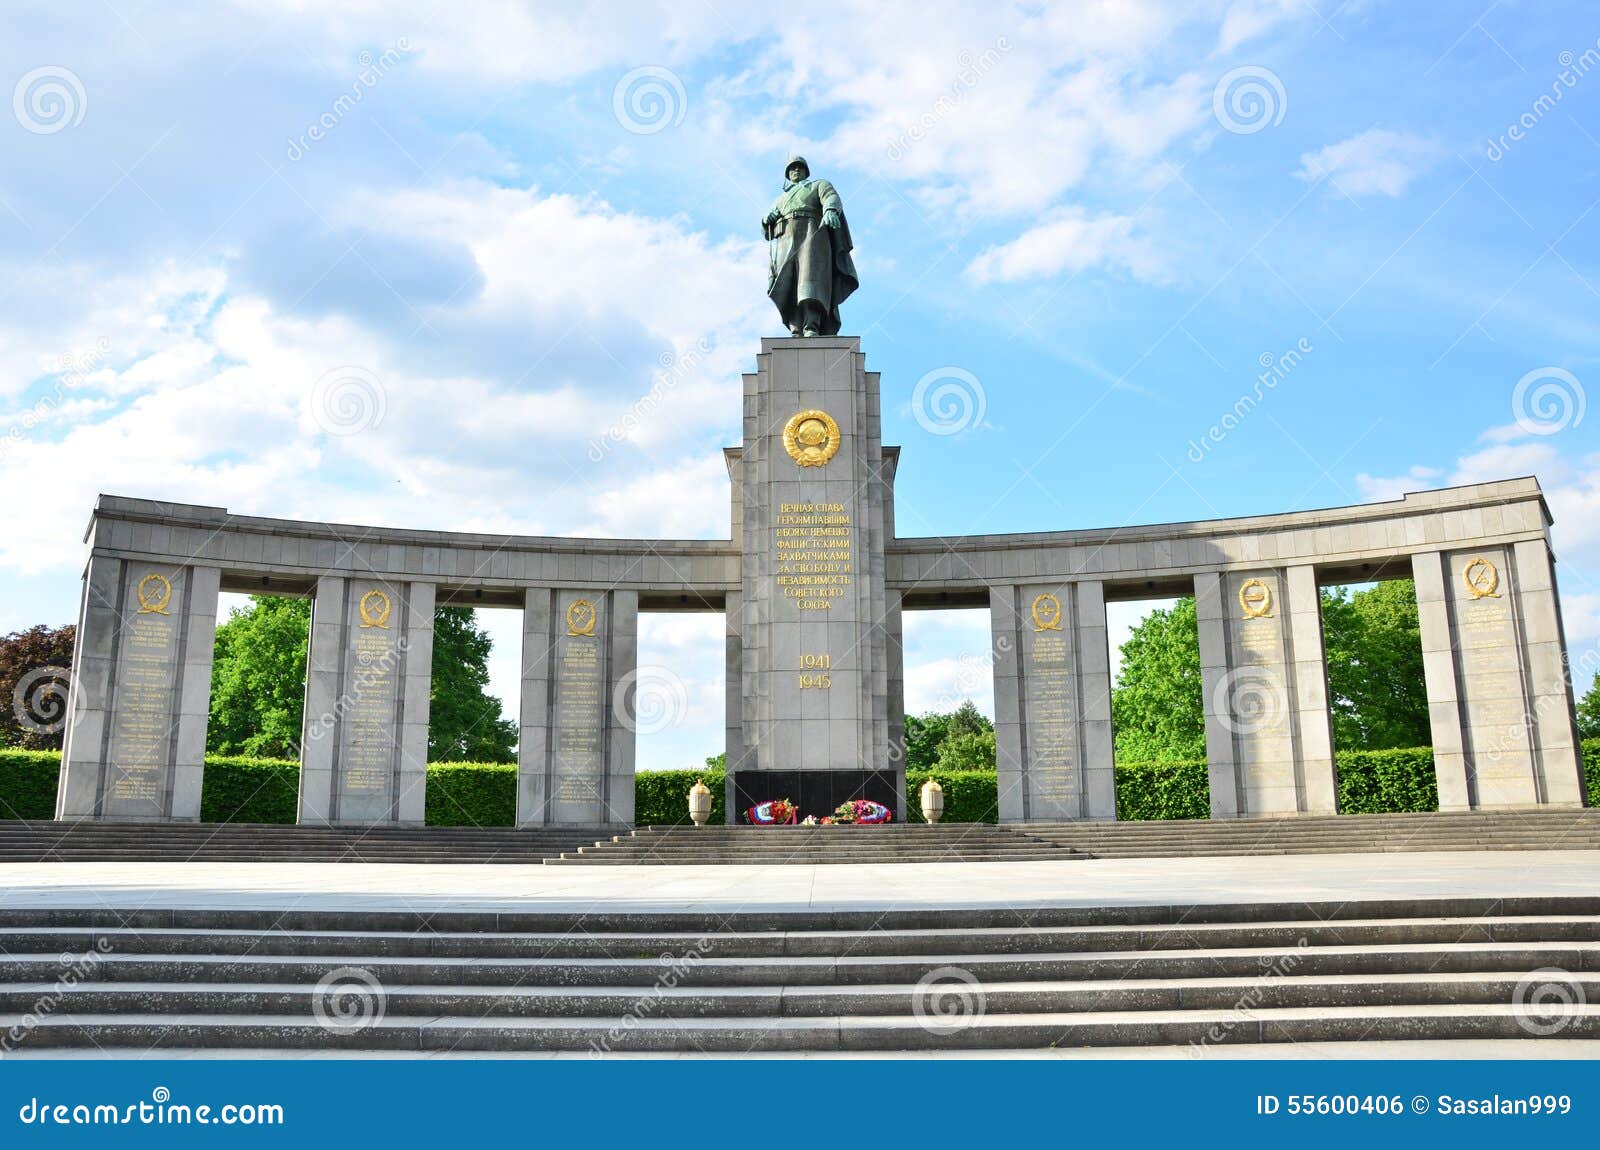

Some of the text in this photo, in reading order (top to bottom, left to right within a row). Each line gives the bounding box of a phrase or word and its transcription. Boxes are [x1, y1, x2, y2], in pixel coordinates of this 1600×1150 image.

[781, 503, 845, 513] ВЕЧНАЯ СЛАВА
[776, 539, 850, 549] ФАШИСТСКИМИ
[777, 551, 850, 561] ЗАХВАТЧИКАМИ
[793, 563, 841, 573] СВОБОДУ
[777, 574, 851, 585] НЕЗАВИСИМОСТЬ
[799, 654, 831, 669] 1941
[799, 674, 832, 689] 1945
